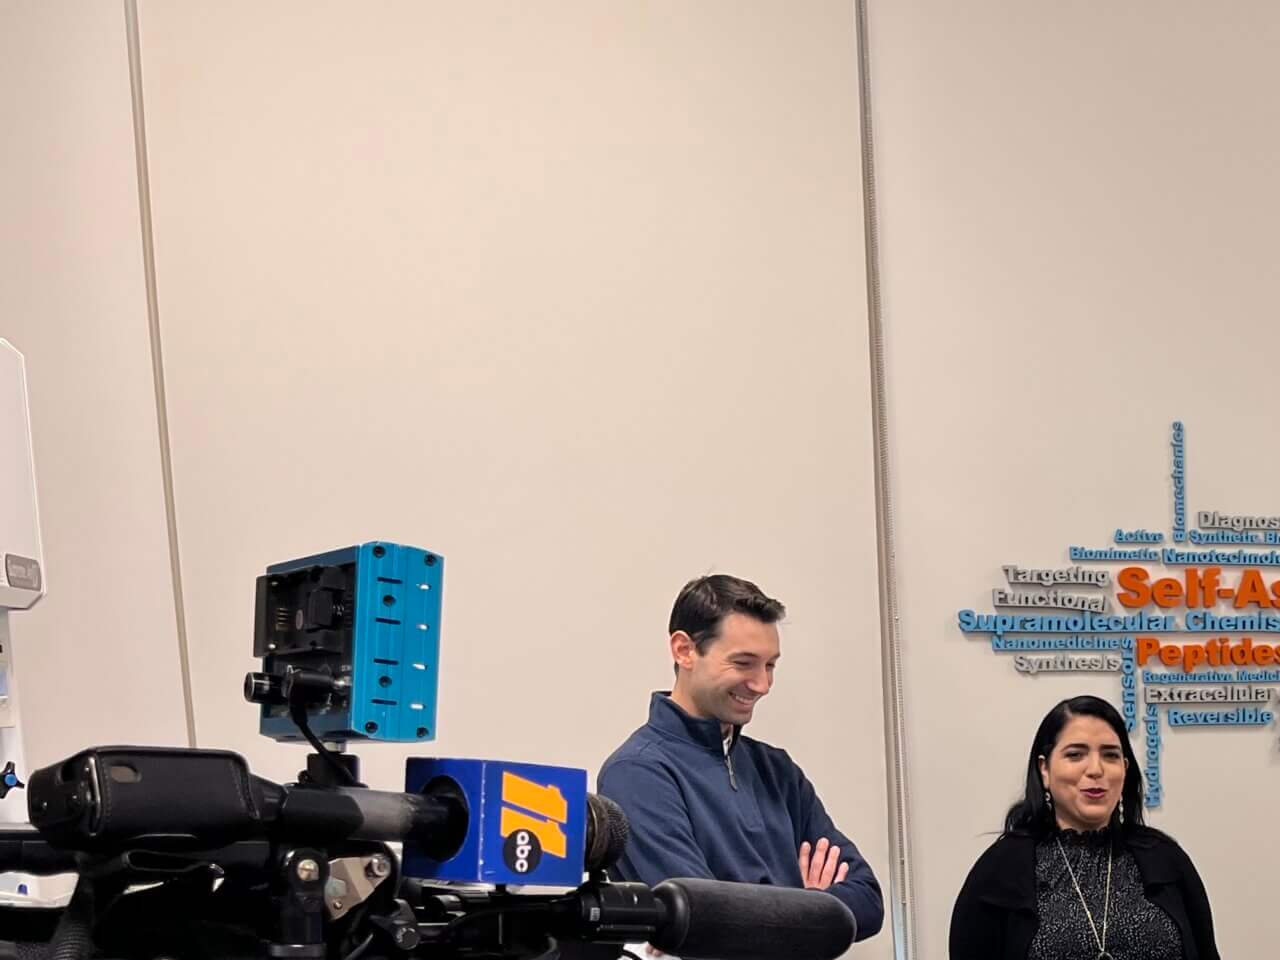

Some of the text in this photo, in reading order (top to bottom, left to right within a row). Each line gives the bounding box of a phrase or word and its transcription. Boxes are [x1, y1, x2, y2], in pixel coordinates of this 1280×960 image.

[1171, 420, 1186, 543] Biomechanics
[1114, 529, 1163, 544] Active
[1189, 530, 1258, 545] Synthetic
[1070, 547, 1159, 561] Biomimetic
[1003, 565, 1111, 586] Targeting
[993, 588, 1107, 613] Functional
[959, 609, 1178, 635] Supramolecular
[1015, 654, 1121, 673] Synthesis
[1143, 671, 1232, 685] Regenerative
[1145, 686, 1278, 704] Extracellular
[1168, 709, 1274, 728] Reversible
[501, 771, 568, 858] 11
[515, 831, 531, 872] abc
